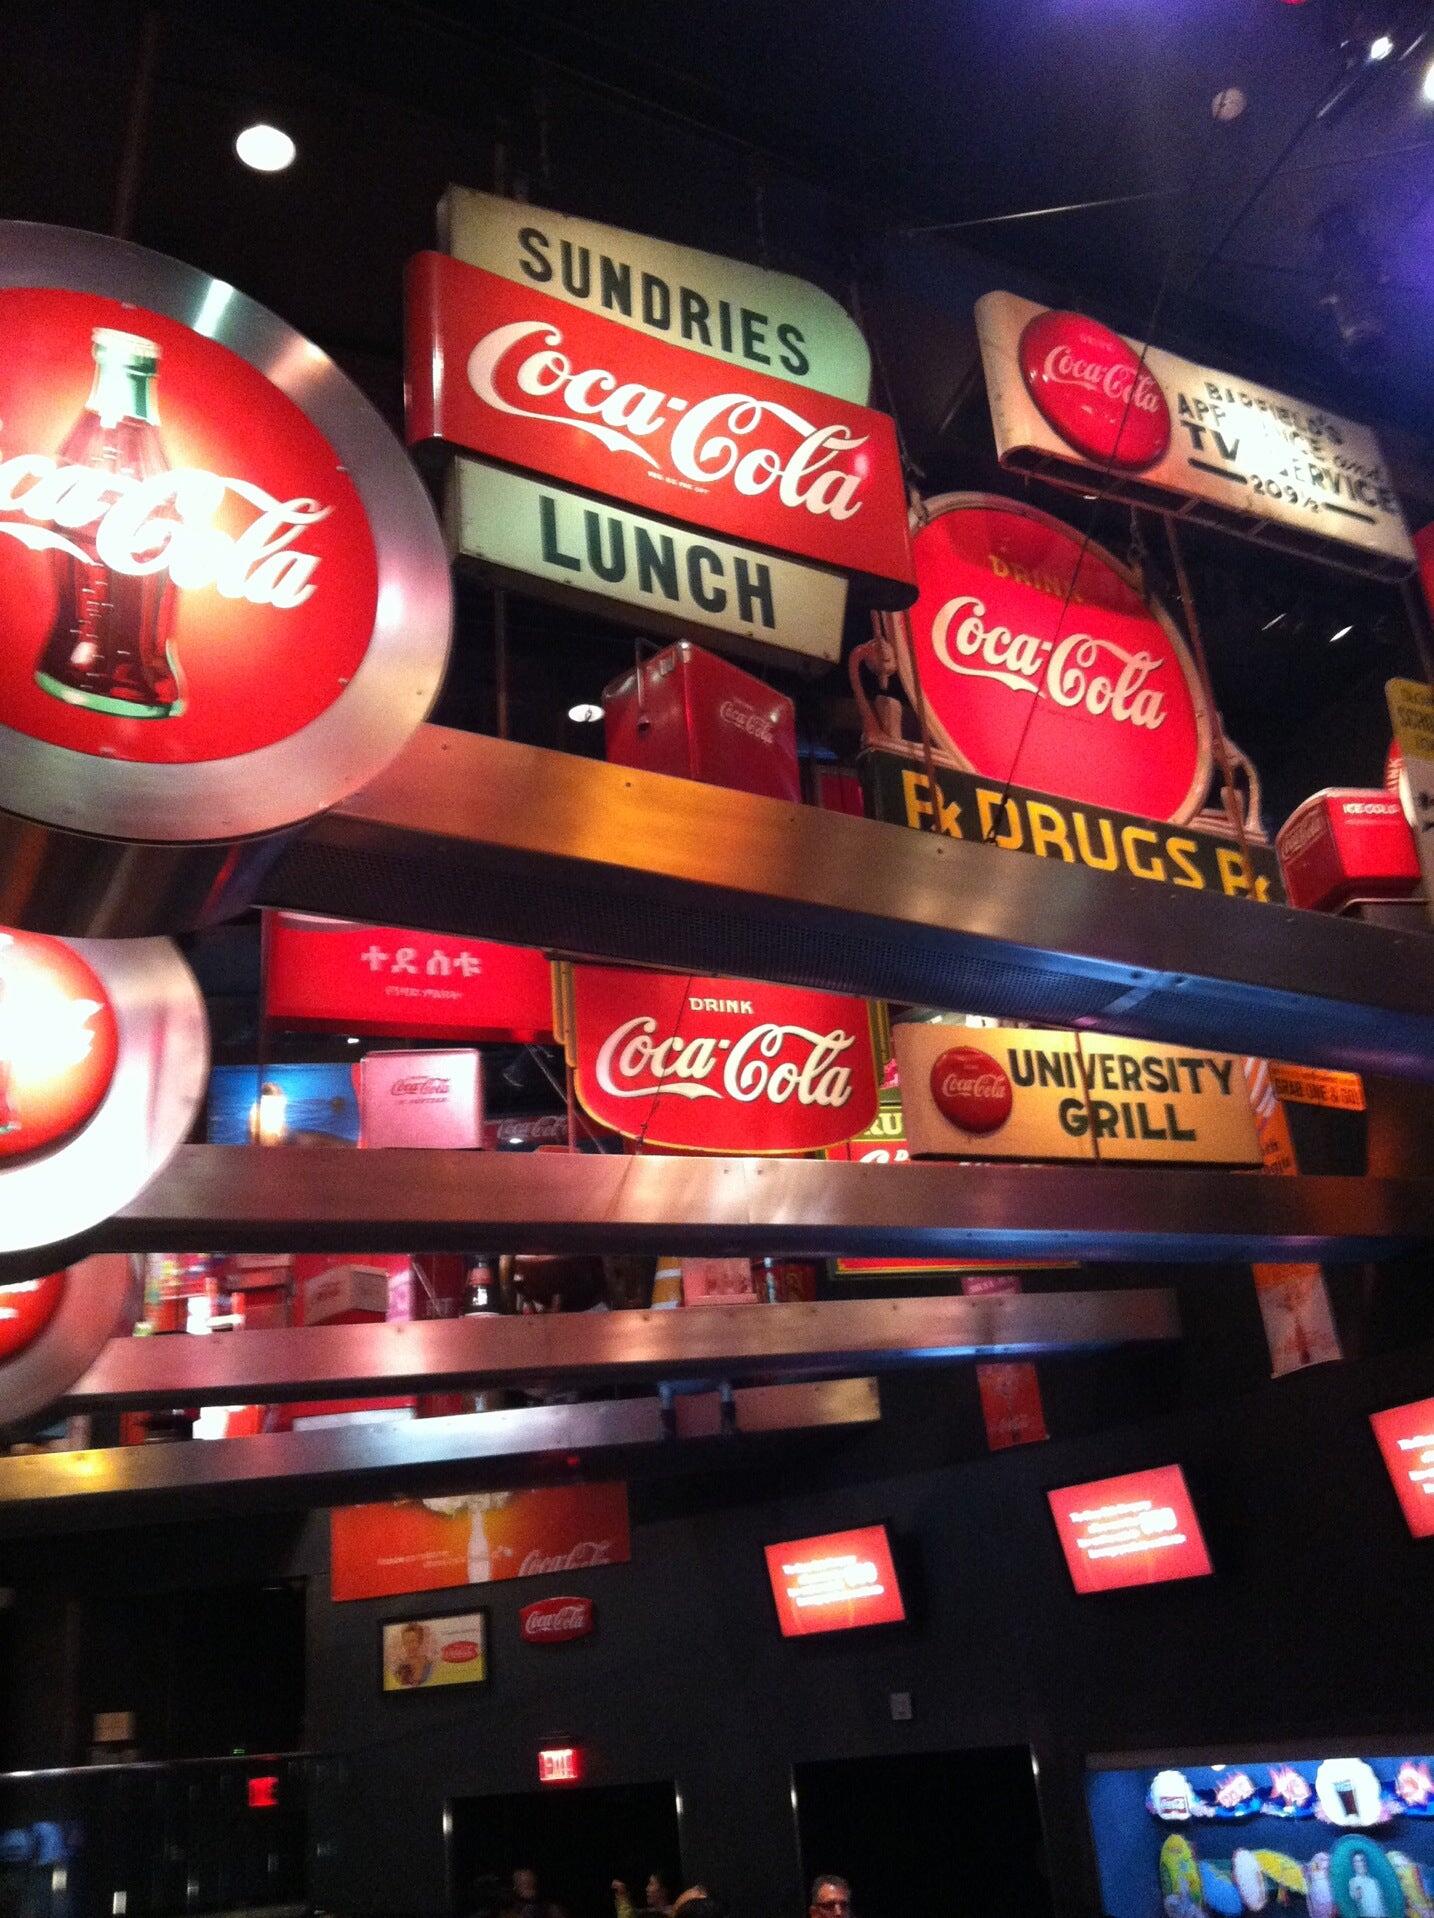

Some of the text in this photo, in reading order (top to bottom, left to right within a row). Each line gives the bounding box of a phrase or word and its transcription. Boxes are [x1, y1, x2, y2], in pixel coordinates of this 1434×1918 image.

[518, 227, 810, 377] SUNDRIES
[1043, 345, 1160, 413] Coca-Cola
[467, 321, 869, 521] Coca-Cola
[1180, 419, 1240, 462] TV
[538, 495, 777, 631] LUNCH
[931, 596, 1167, 731] Coca-Cola
[975, 788, 1206, 890] DRUGS
[689, 997, 754, 1015] DRINK
[596, 1016, 855, 1107] Coca-Cola
[942, 1073, 1006, 1099] Coca-Cola
[1007, 1048, 1233, 1095] UNIVERSITY
[1058, 1097, 1197, 1142] GRILL
[525, 1604, 586, 1635] Coca-Cola
